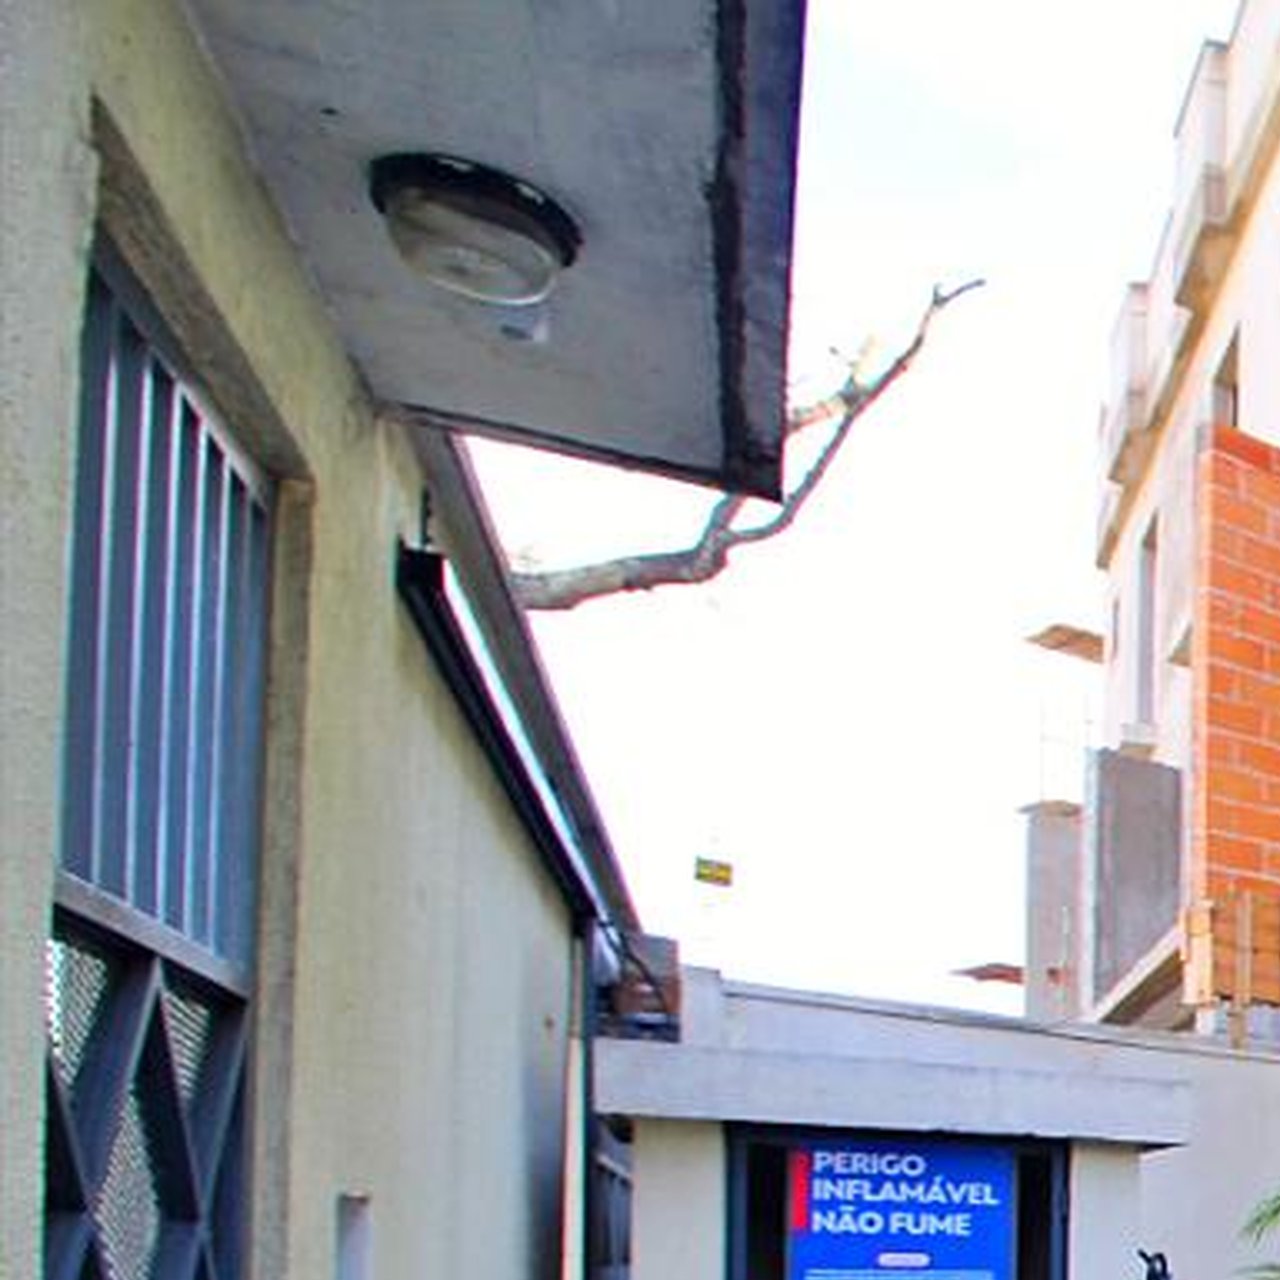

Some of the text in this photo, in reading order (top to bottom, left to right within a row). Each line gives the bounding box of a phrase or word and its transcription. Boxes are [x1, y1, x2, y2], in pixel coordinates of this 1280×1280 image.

[813, 1151, 926, 1176] PERIGO
[812, 1175, 999, 1205] INFLAMÁVEL
[811, 1205, 972, 1236] NÃO FUME
